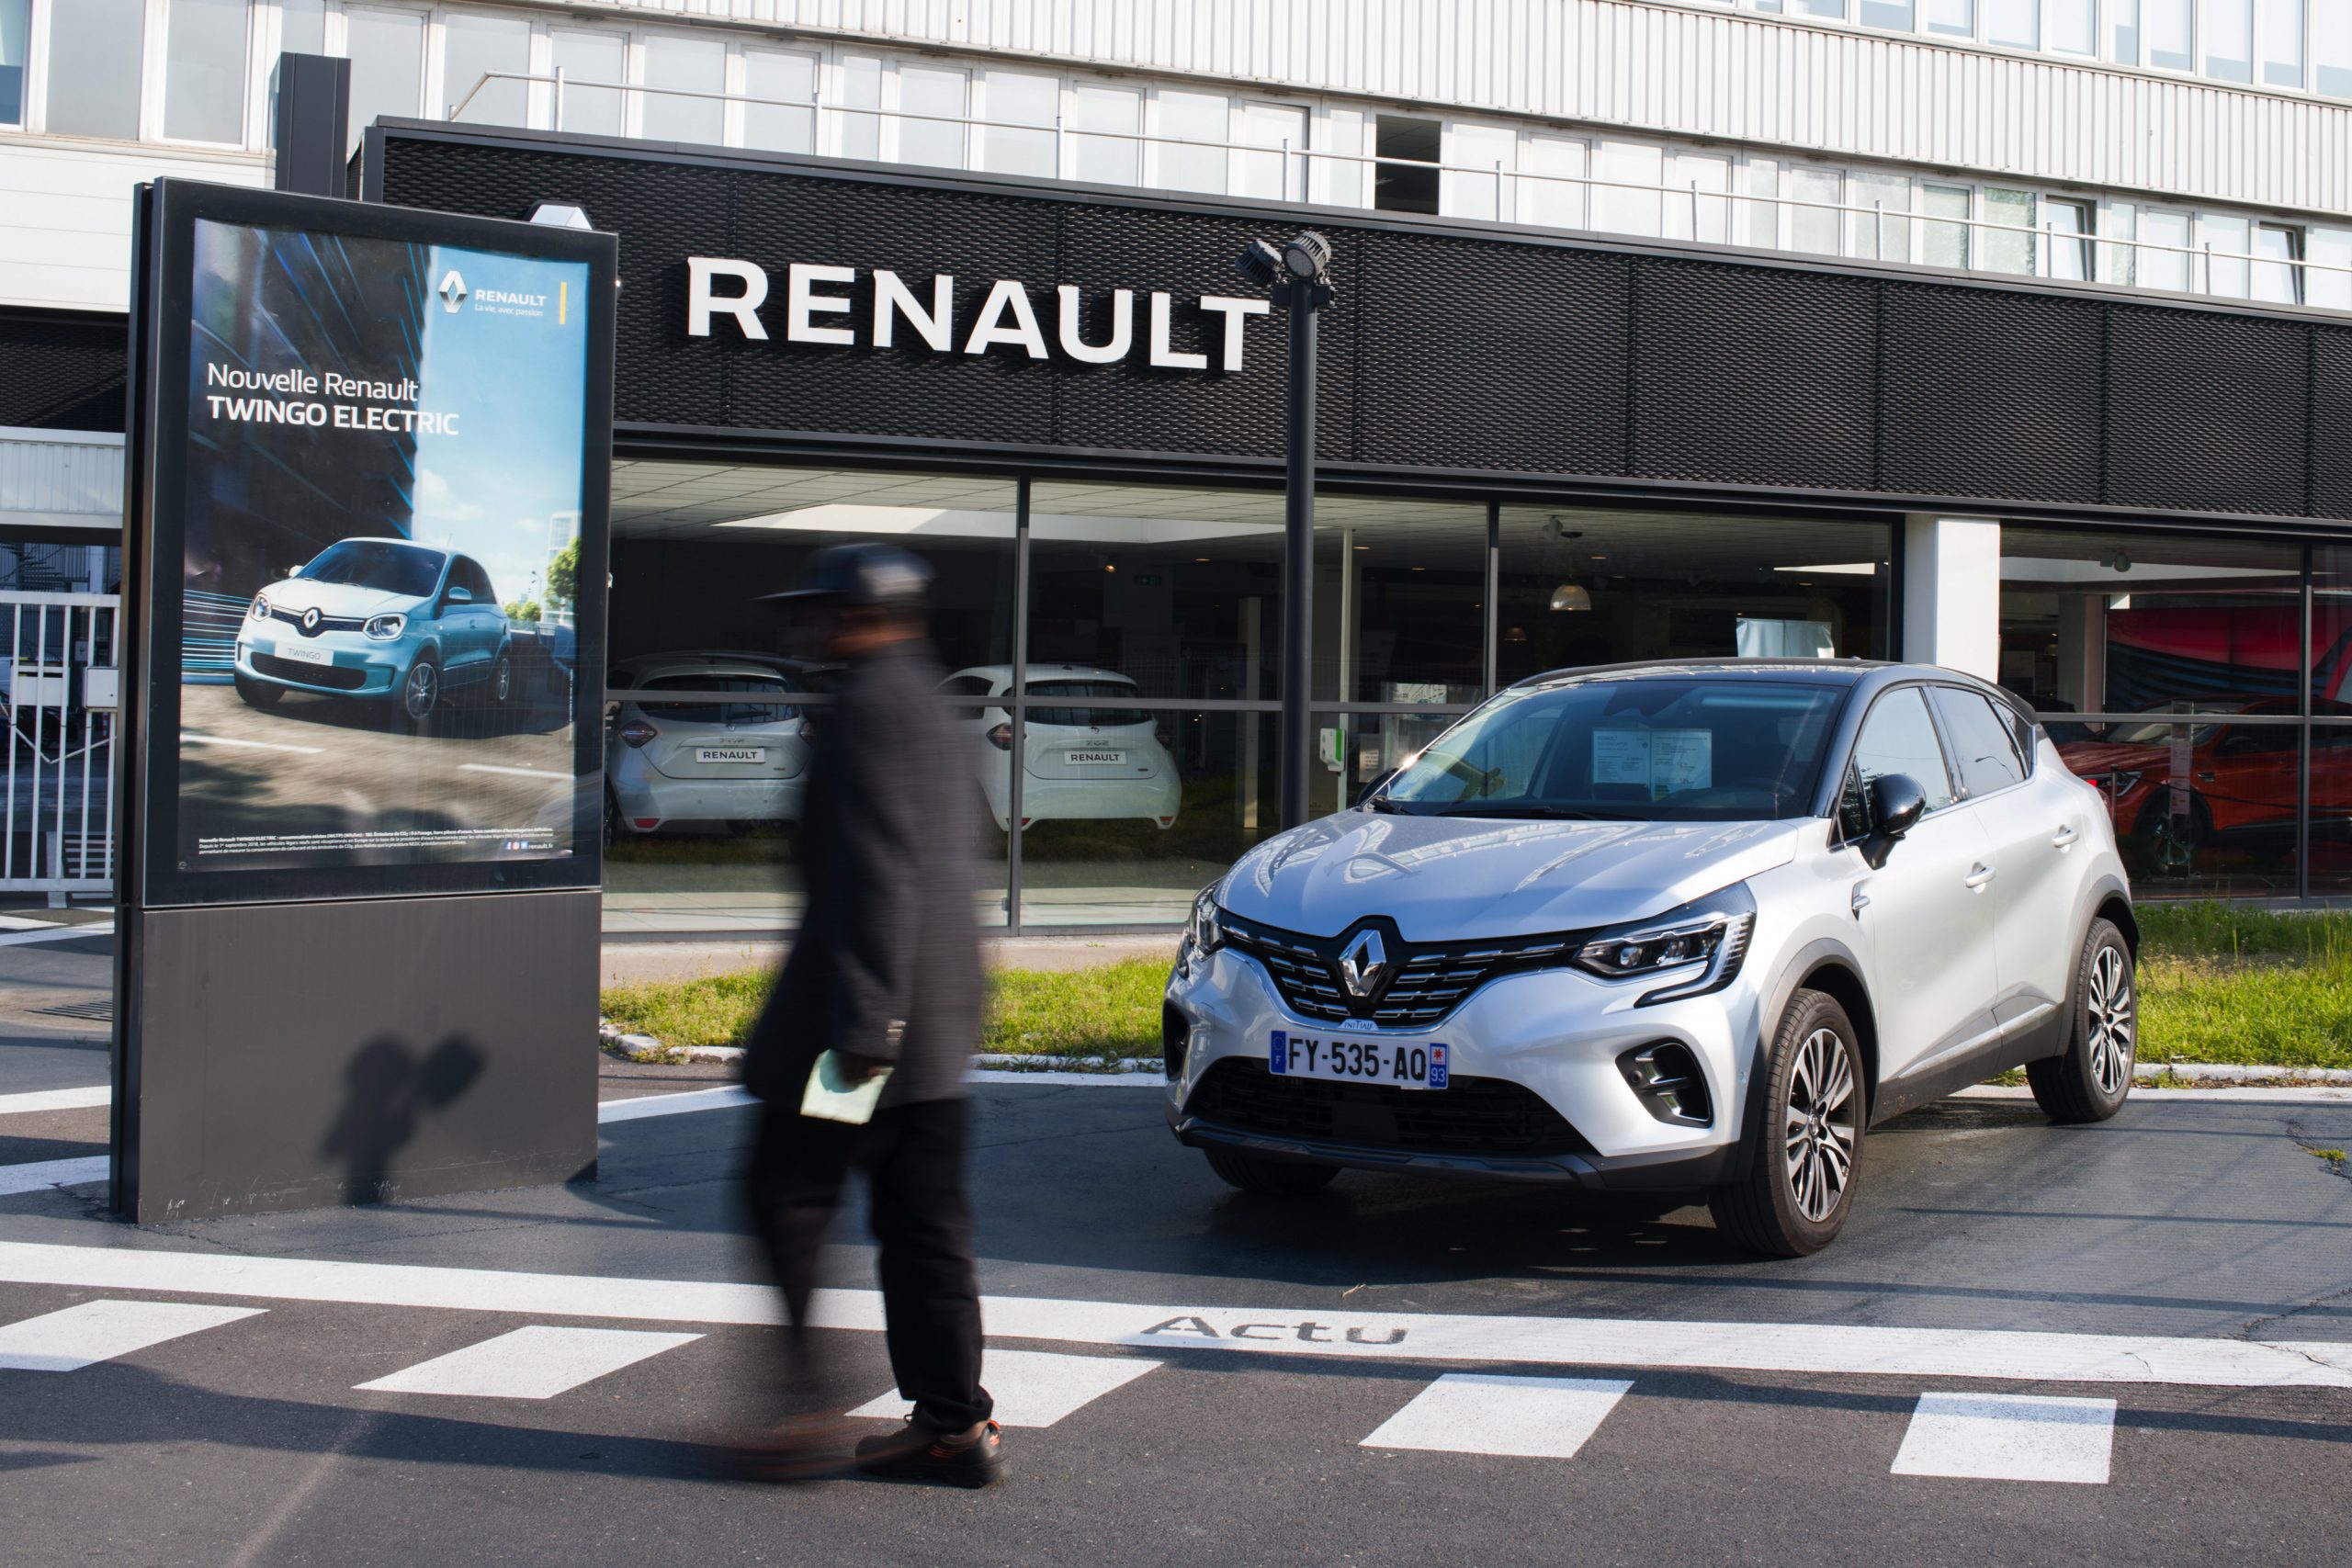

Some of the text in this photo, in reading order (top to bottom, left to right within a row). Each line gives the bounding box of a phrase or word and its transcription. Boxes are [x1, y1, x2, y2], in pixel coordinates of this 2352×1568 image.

[475, 289, 546, 306] RENAULT
[515, 308, 543, 317] passion
[688, 256, 1270, 371] RENAULT
[208, 363, 419, 402] Nouvelle Renault
[208, 395, 459, 435] TWINGO ELECTRIC
[288, 649, 321, 660] TWINGO
[1289, 1038, 1427, 1081] FY-535-AQ
[1431, 1066, 1446, 1083] 93
[1140, 1315, 1408, 1345] Actu
